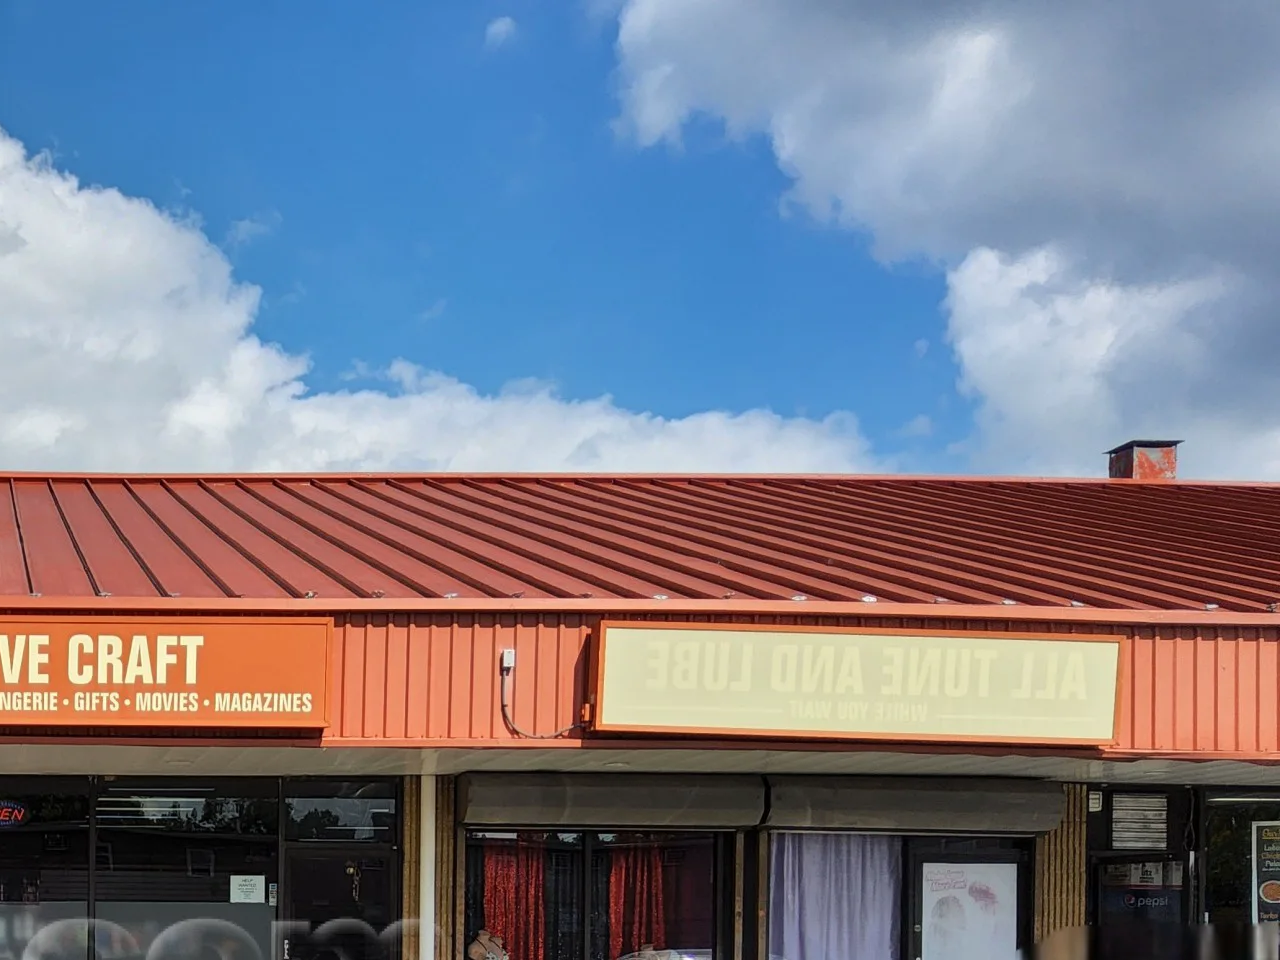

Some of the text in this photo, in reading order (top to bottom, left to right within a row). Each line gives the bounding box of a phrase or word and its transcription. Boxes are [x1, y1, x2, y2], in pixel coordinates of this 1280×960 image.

[67, 634, 204, 685] CRAFT
[73, 691, 120, 712] GIFTS
[135, 692, 199, 712] MOVIES
[214, 692, 313, 713] MAGAZINES
[1137, 896, 1168, 908] pepsi
